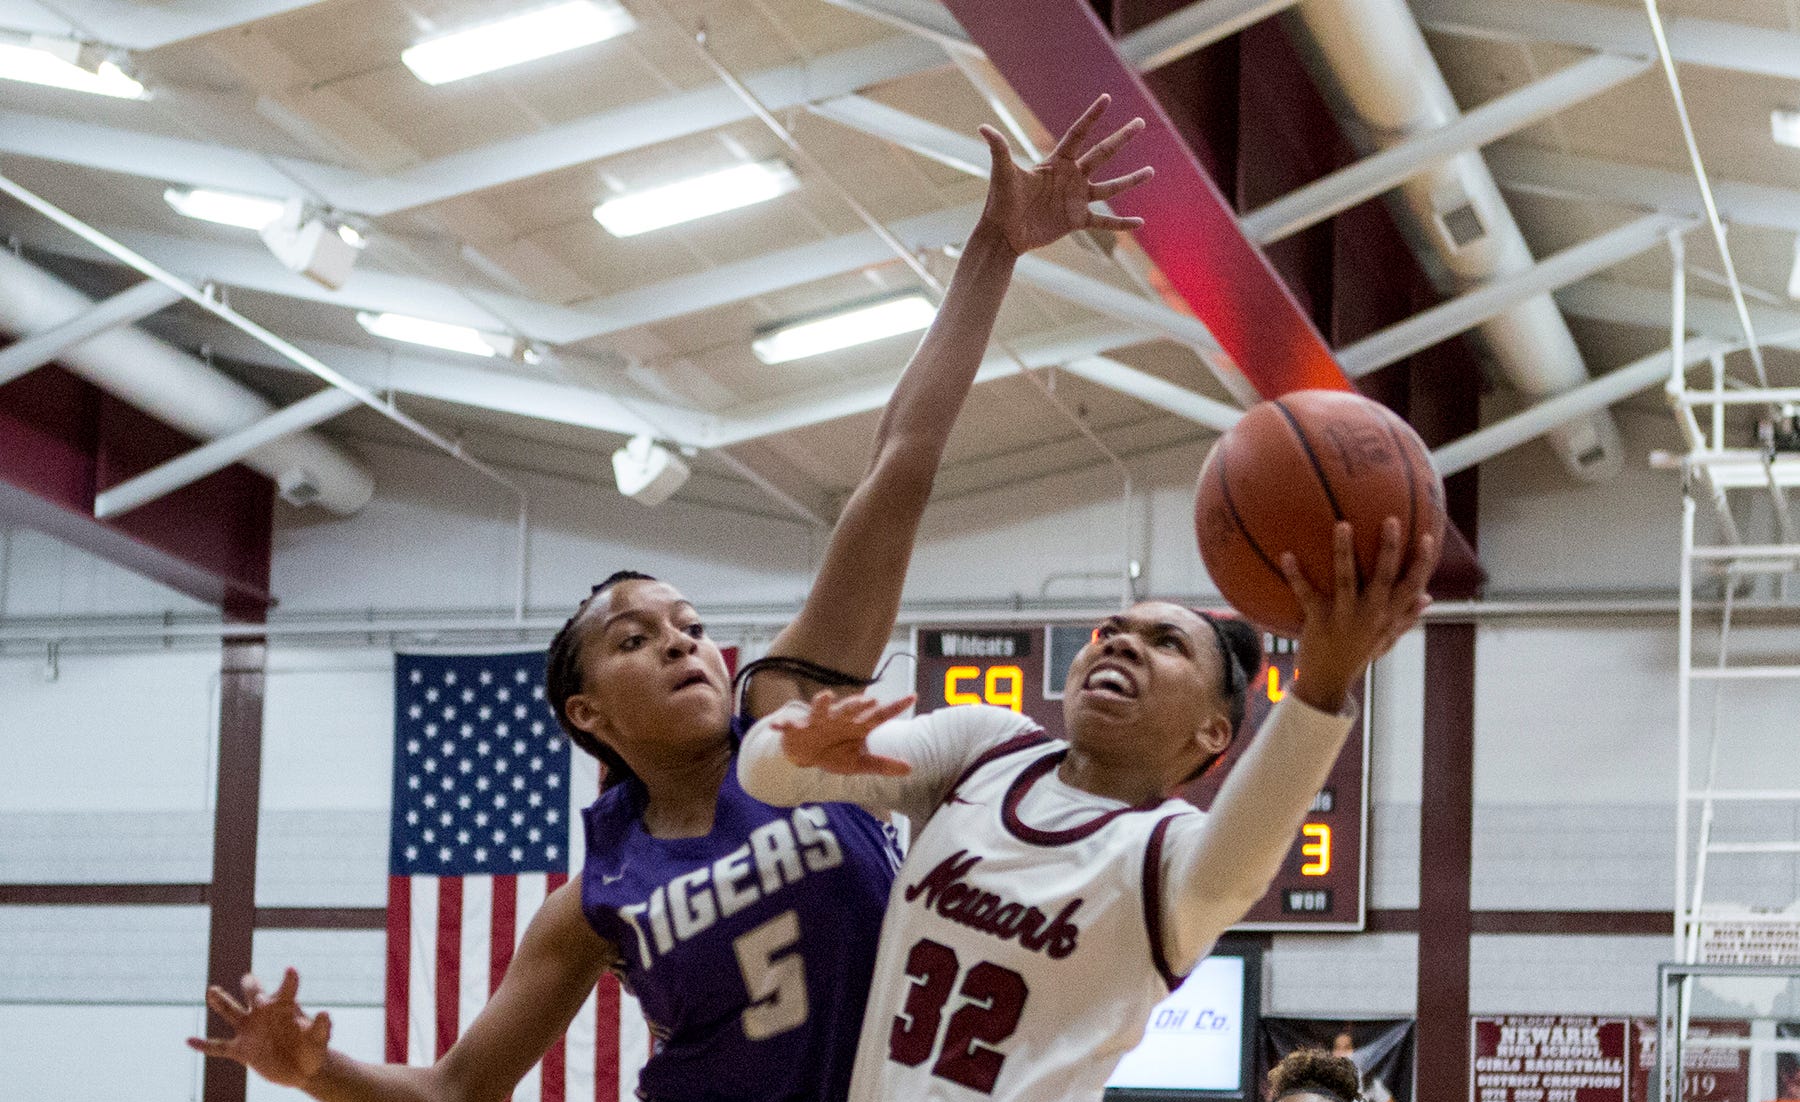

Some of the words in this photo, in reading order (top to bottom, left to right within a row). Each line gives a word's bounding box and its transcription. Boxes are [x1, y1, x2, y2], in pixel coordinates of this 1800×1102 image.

[941, 633, 1014, 657] Wildcats
[945, 665, 1024, 714] 59
[1302, 823, 1332, 876] 3
[619, 804, 843, 971] TIGERS
[905, 849, 1084, 960] Newark
[733, 909, 809, 1041] 5
[890, 936, 1030, 1096] 32
[1155, 1009, 1189, 1029] Oil
[1195, 1009, 1231, 1031] Co.
[1496, 1045, 1536, 1058] HIGH
[1540, 1045, 1603, 1059] SCHOOL
[1500, 1027, 1600, 1045] NEWARK
[1476, 1058, 1521, 1072] GIRLS
[1524, 1058, 1622, 1073] BASKETBALL
[1477, 1074, 1540, 1087] DISTRICT
[1542, 1075, 1621, 1089] CHAMPIONS
